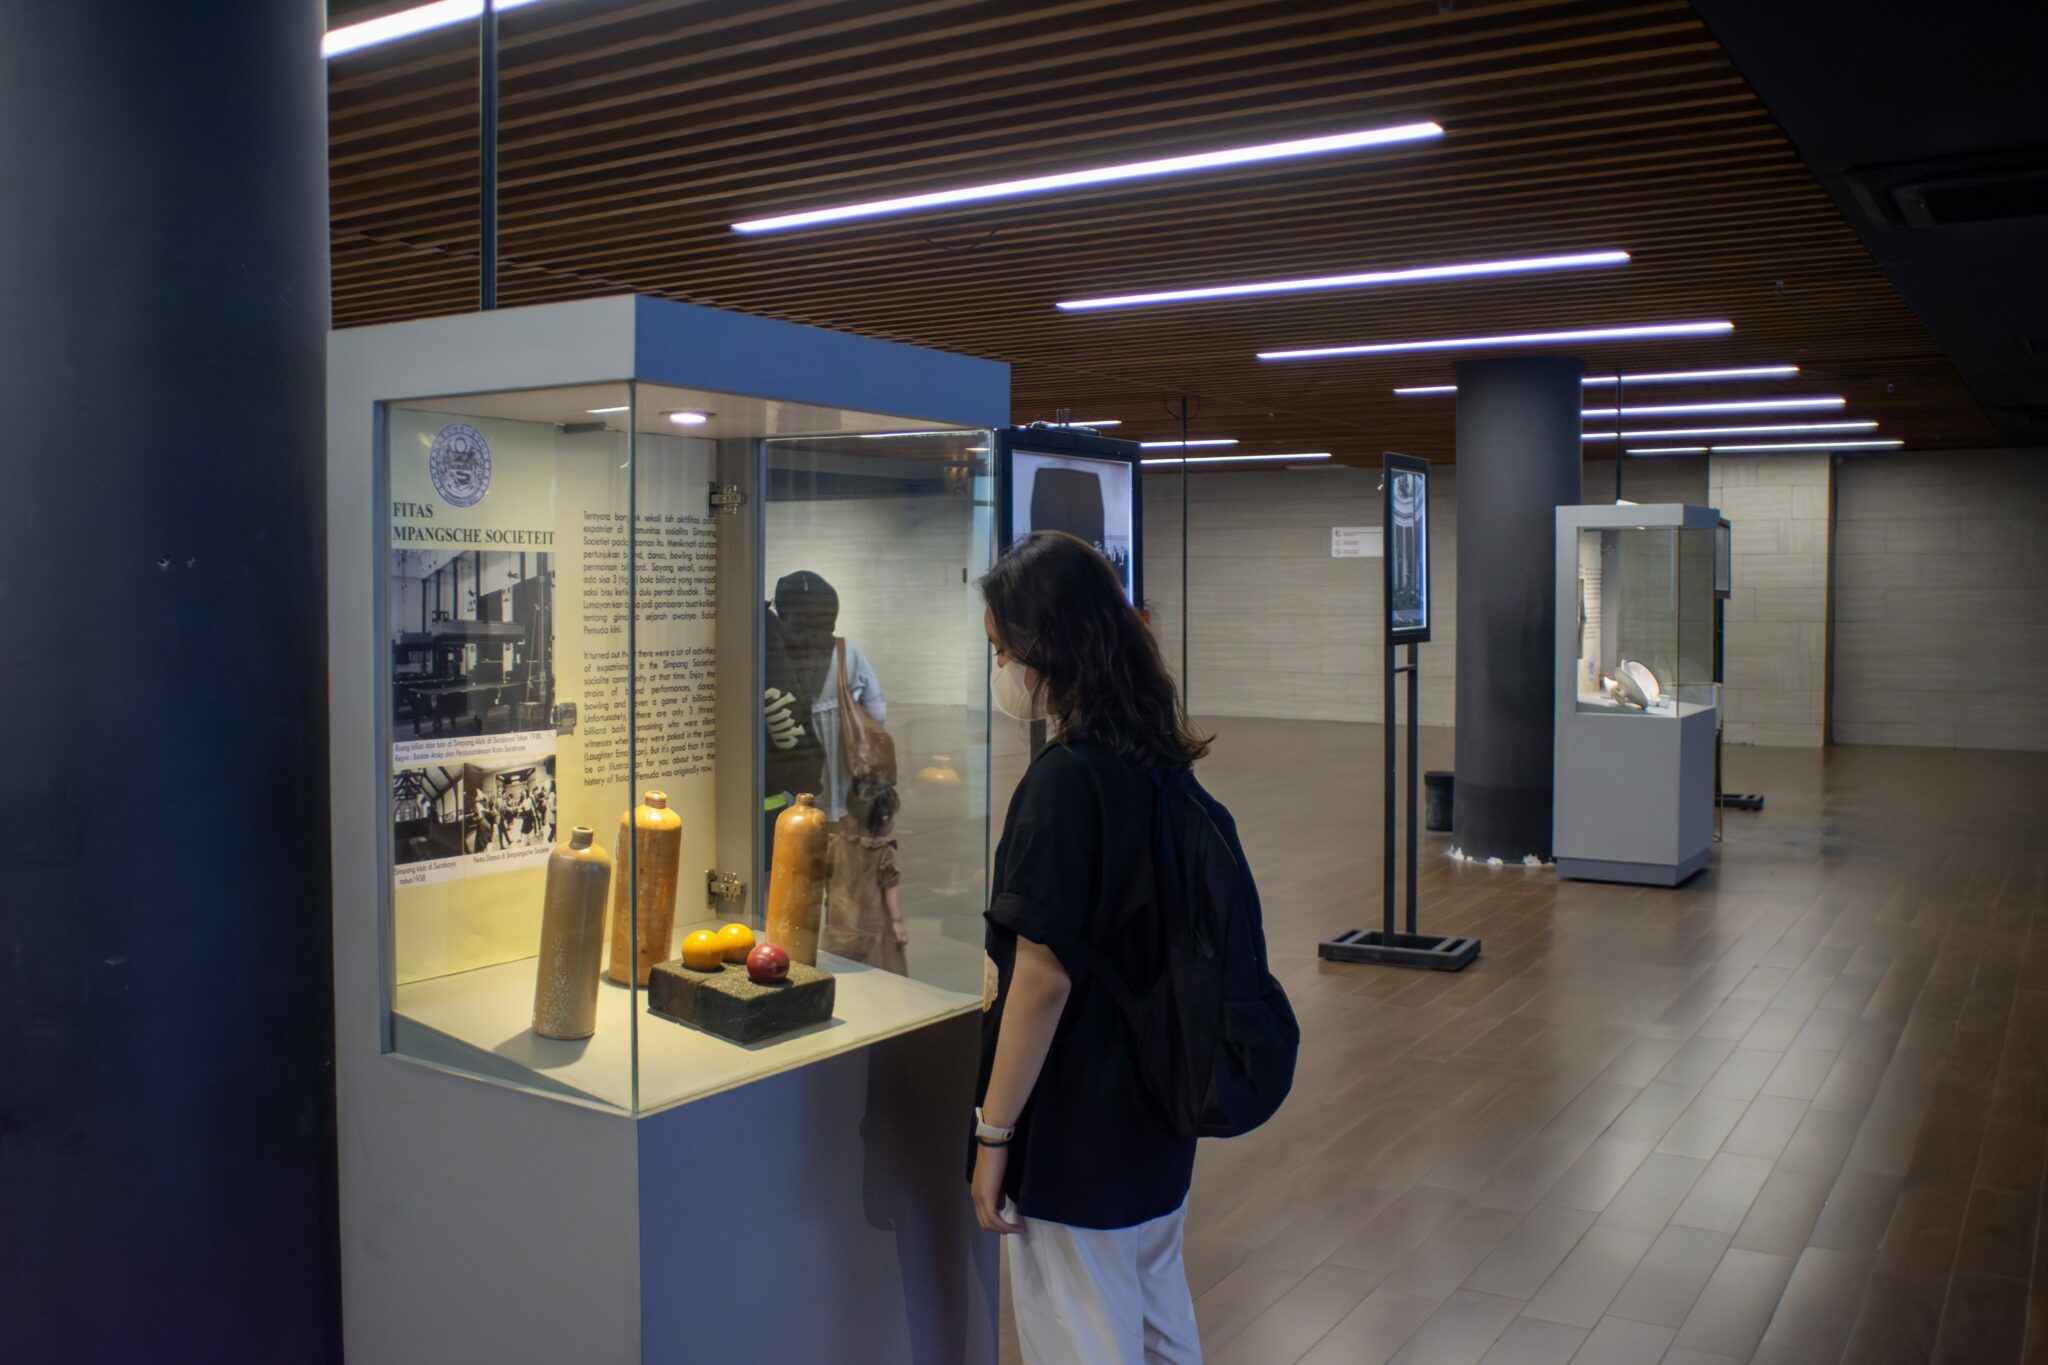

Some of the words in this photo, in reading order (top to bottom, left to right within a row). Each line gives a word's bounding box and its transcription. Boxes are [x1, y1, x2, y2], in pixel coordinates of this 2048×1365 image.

[394, 502, 433, 518] FITAS
[644, 514, 661, 522] sekali
[665, 514, 674, 522] lah
[393, 526, 481, 542] MPANGSCHE
[485, 529, 555, 545] SOCIETEIT
[617, 525, 623, 534] di
[633, 527, 660, 535] omunitas
[693, 528, 717, 538] Simpang
[670, 552, 692, 561] bowling
[652, 563, 673, 573] Sayang
[640, 575, 653, 583] bola
[677, 577, 692, 585] yang
[639, 588, 651, 596] dulu
[654, 588, 675, 597] pernah
[654, 600, 684, 610] gambaran
[686, 600, 698, 608] buat
[645, 613, 667, 622] sejarah
[611, 651, 620, 659] out
[638, 649, 653, 658] there
[685, 647, 692, 656] of
[584, 664, 591, 672] of
[649, 661, 658, 669] the
[663, 660, 688, 670] Simpang
[584, 676, 609, 685] socialite
[690, 670, 704, 680] Enjoy
[584, 690, 604, 698] strains
[611, 687, 618, 696] of
[584, 702, 609, 711] bowling
[614, 699, 626, 708] and
[661, 698, 677, 706] game
[682, 695, 688, 703] of
[672, 709, 683, 717] only
[584, 727, 606, 736] billiard
[668, 720, 679, 728] who
[667, 732, 685, 742] poked
[650, 746, 659, 754] But
[671, 744, 686, 754] good
[584, 765, 593, 774] be
[646, 759, 654, 767] for
[659, 760, 669, 768] you
[673, 756, 689, 764] about
[584, 776, 604, 786] history
[607, 776, 613, 784] of
[674, 768, 699, 777] originally
